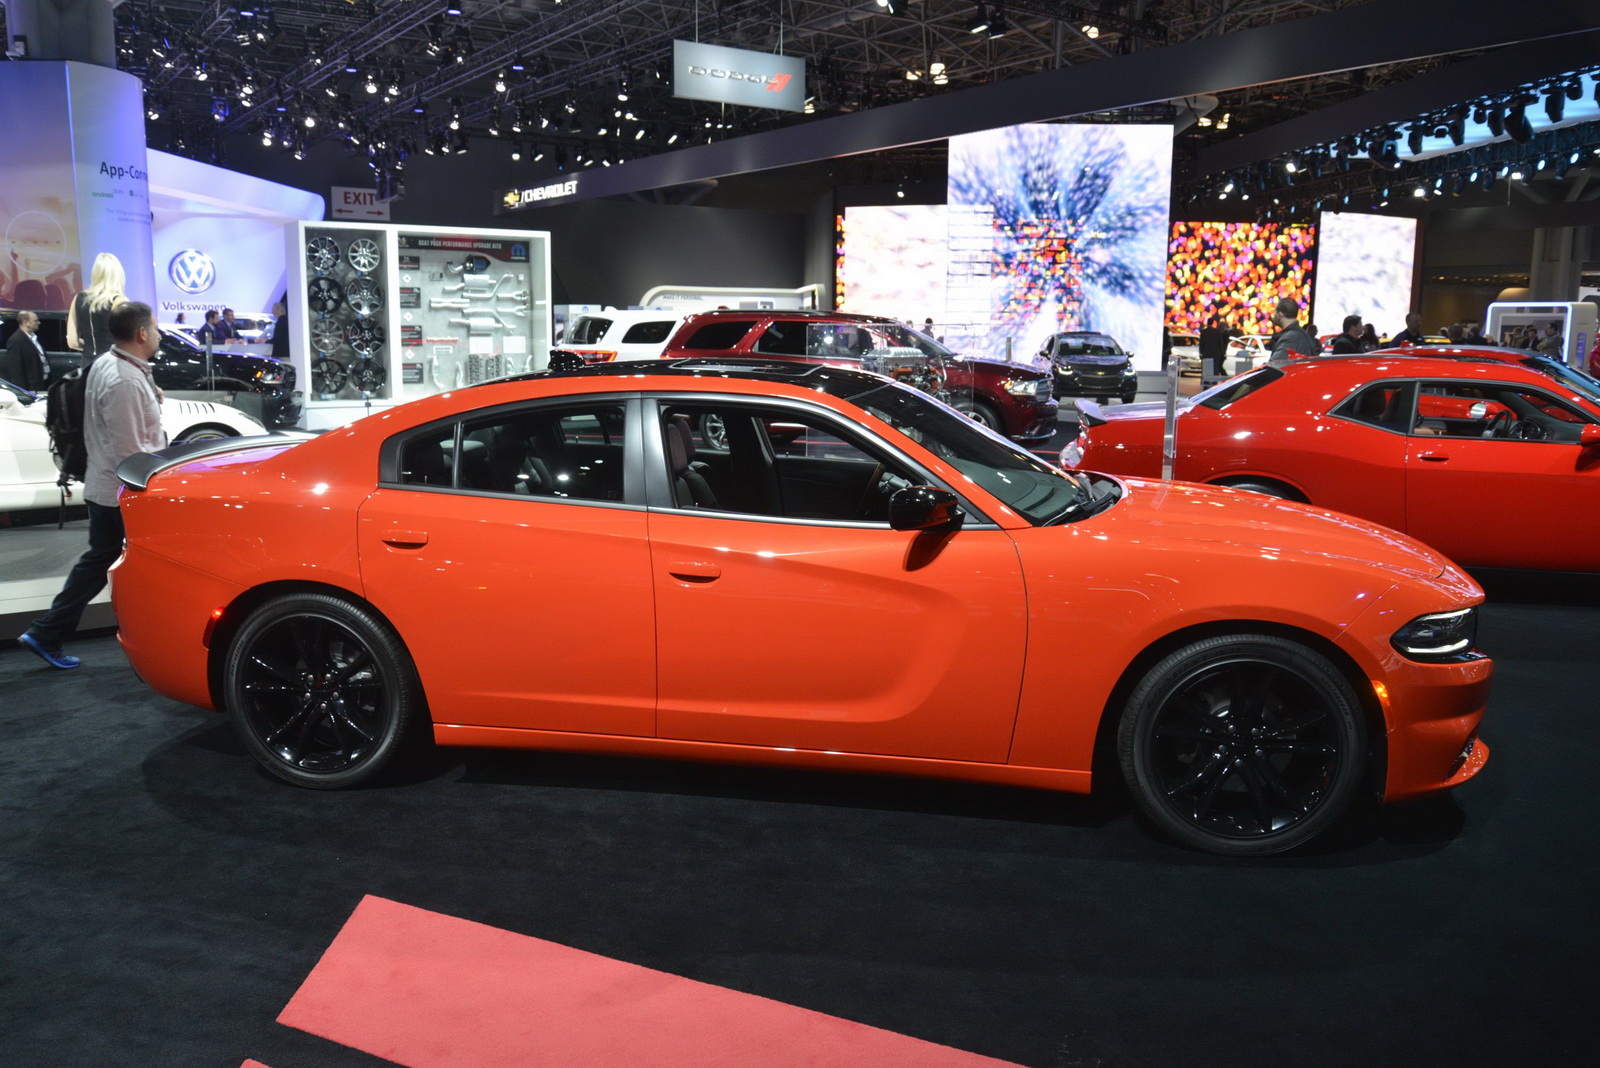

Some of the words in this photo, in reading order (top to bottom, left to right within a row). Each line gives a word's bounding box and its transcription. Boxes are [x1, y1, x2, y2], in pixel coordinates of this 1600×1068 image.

[688, 65, 778, 85] DODGE
[343, 191, 376, 206] EXIT
[524, 181, 578, 202] CHEVROLET
[162, 301, 227, 314] Volkswagen
